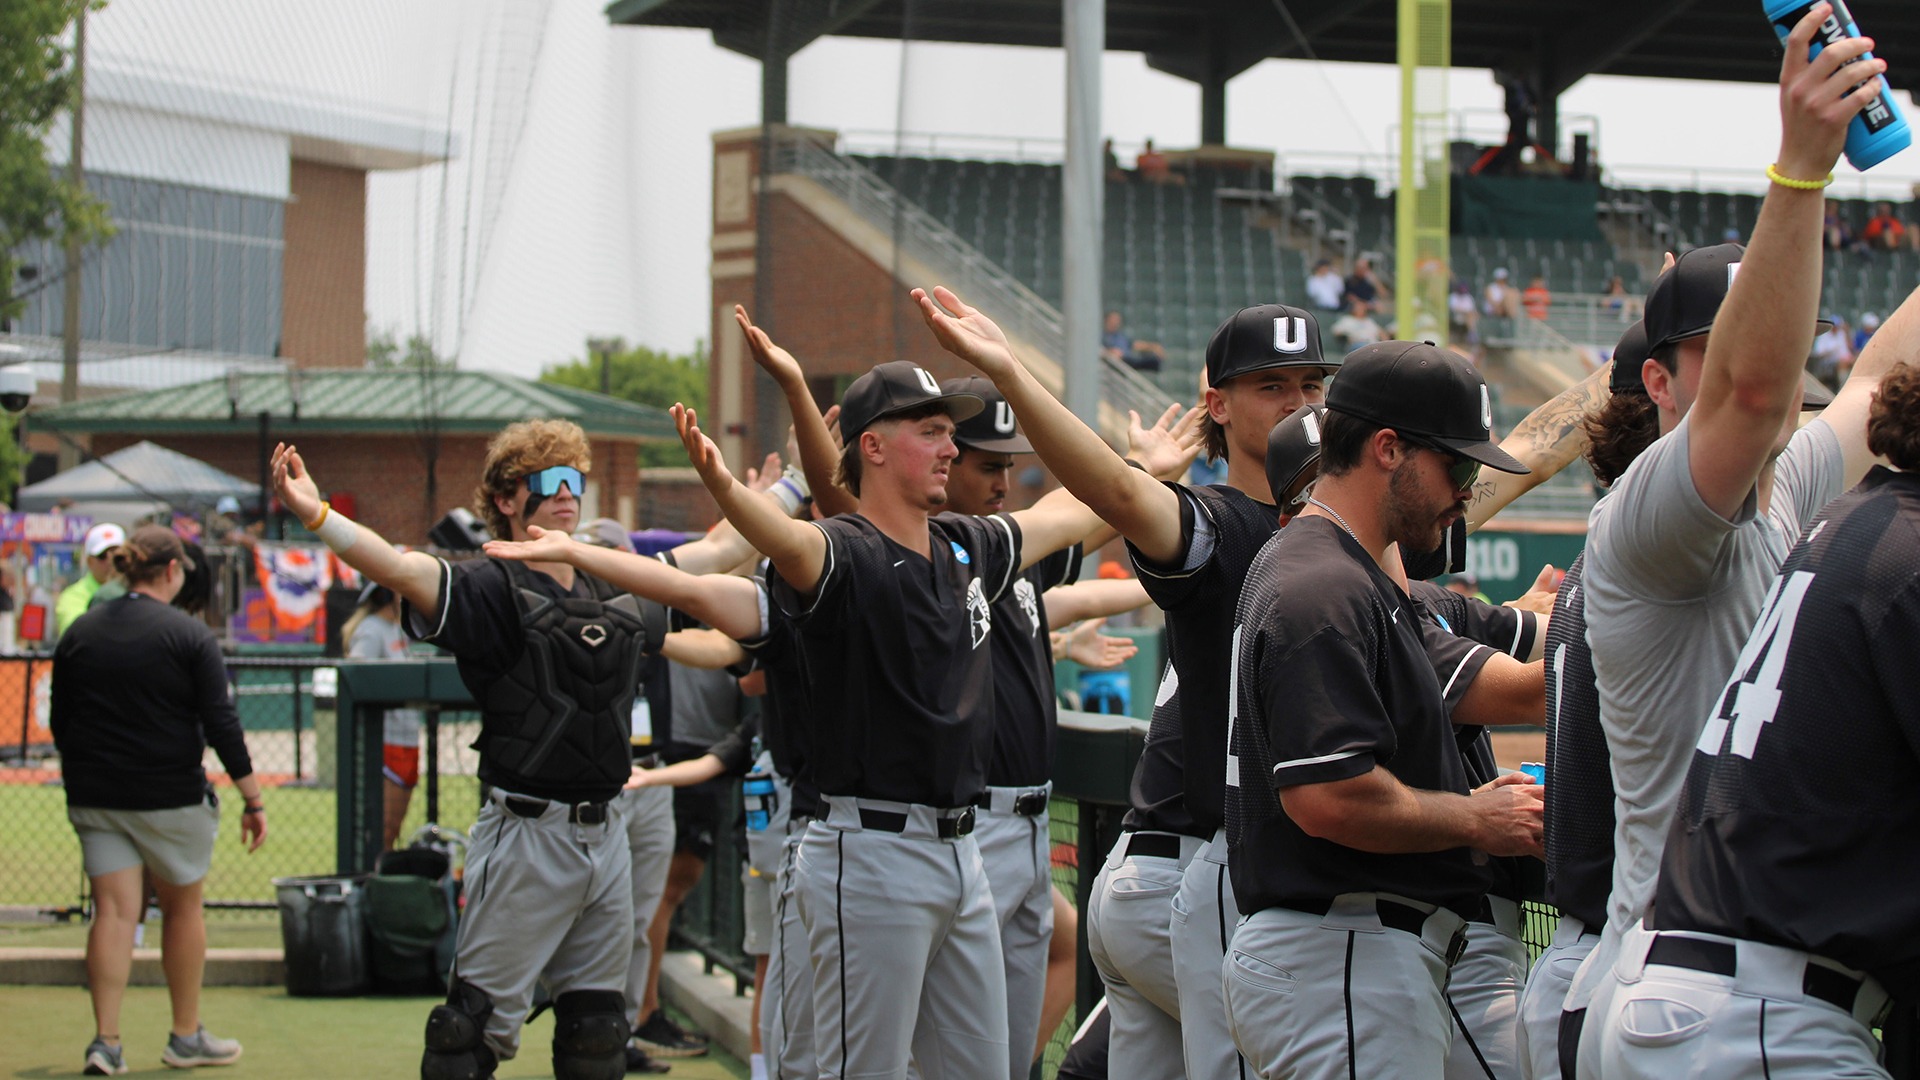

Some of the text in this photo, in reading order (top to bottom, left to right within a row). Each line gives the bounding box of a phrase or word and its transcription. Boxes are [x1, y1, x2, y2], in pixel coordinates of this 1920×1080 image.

[1273, 316, 1308, 354] U
[913, 367, 942, 396] U
[994, 401, 1015, 433] U
